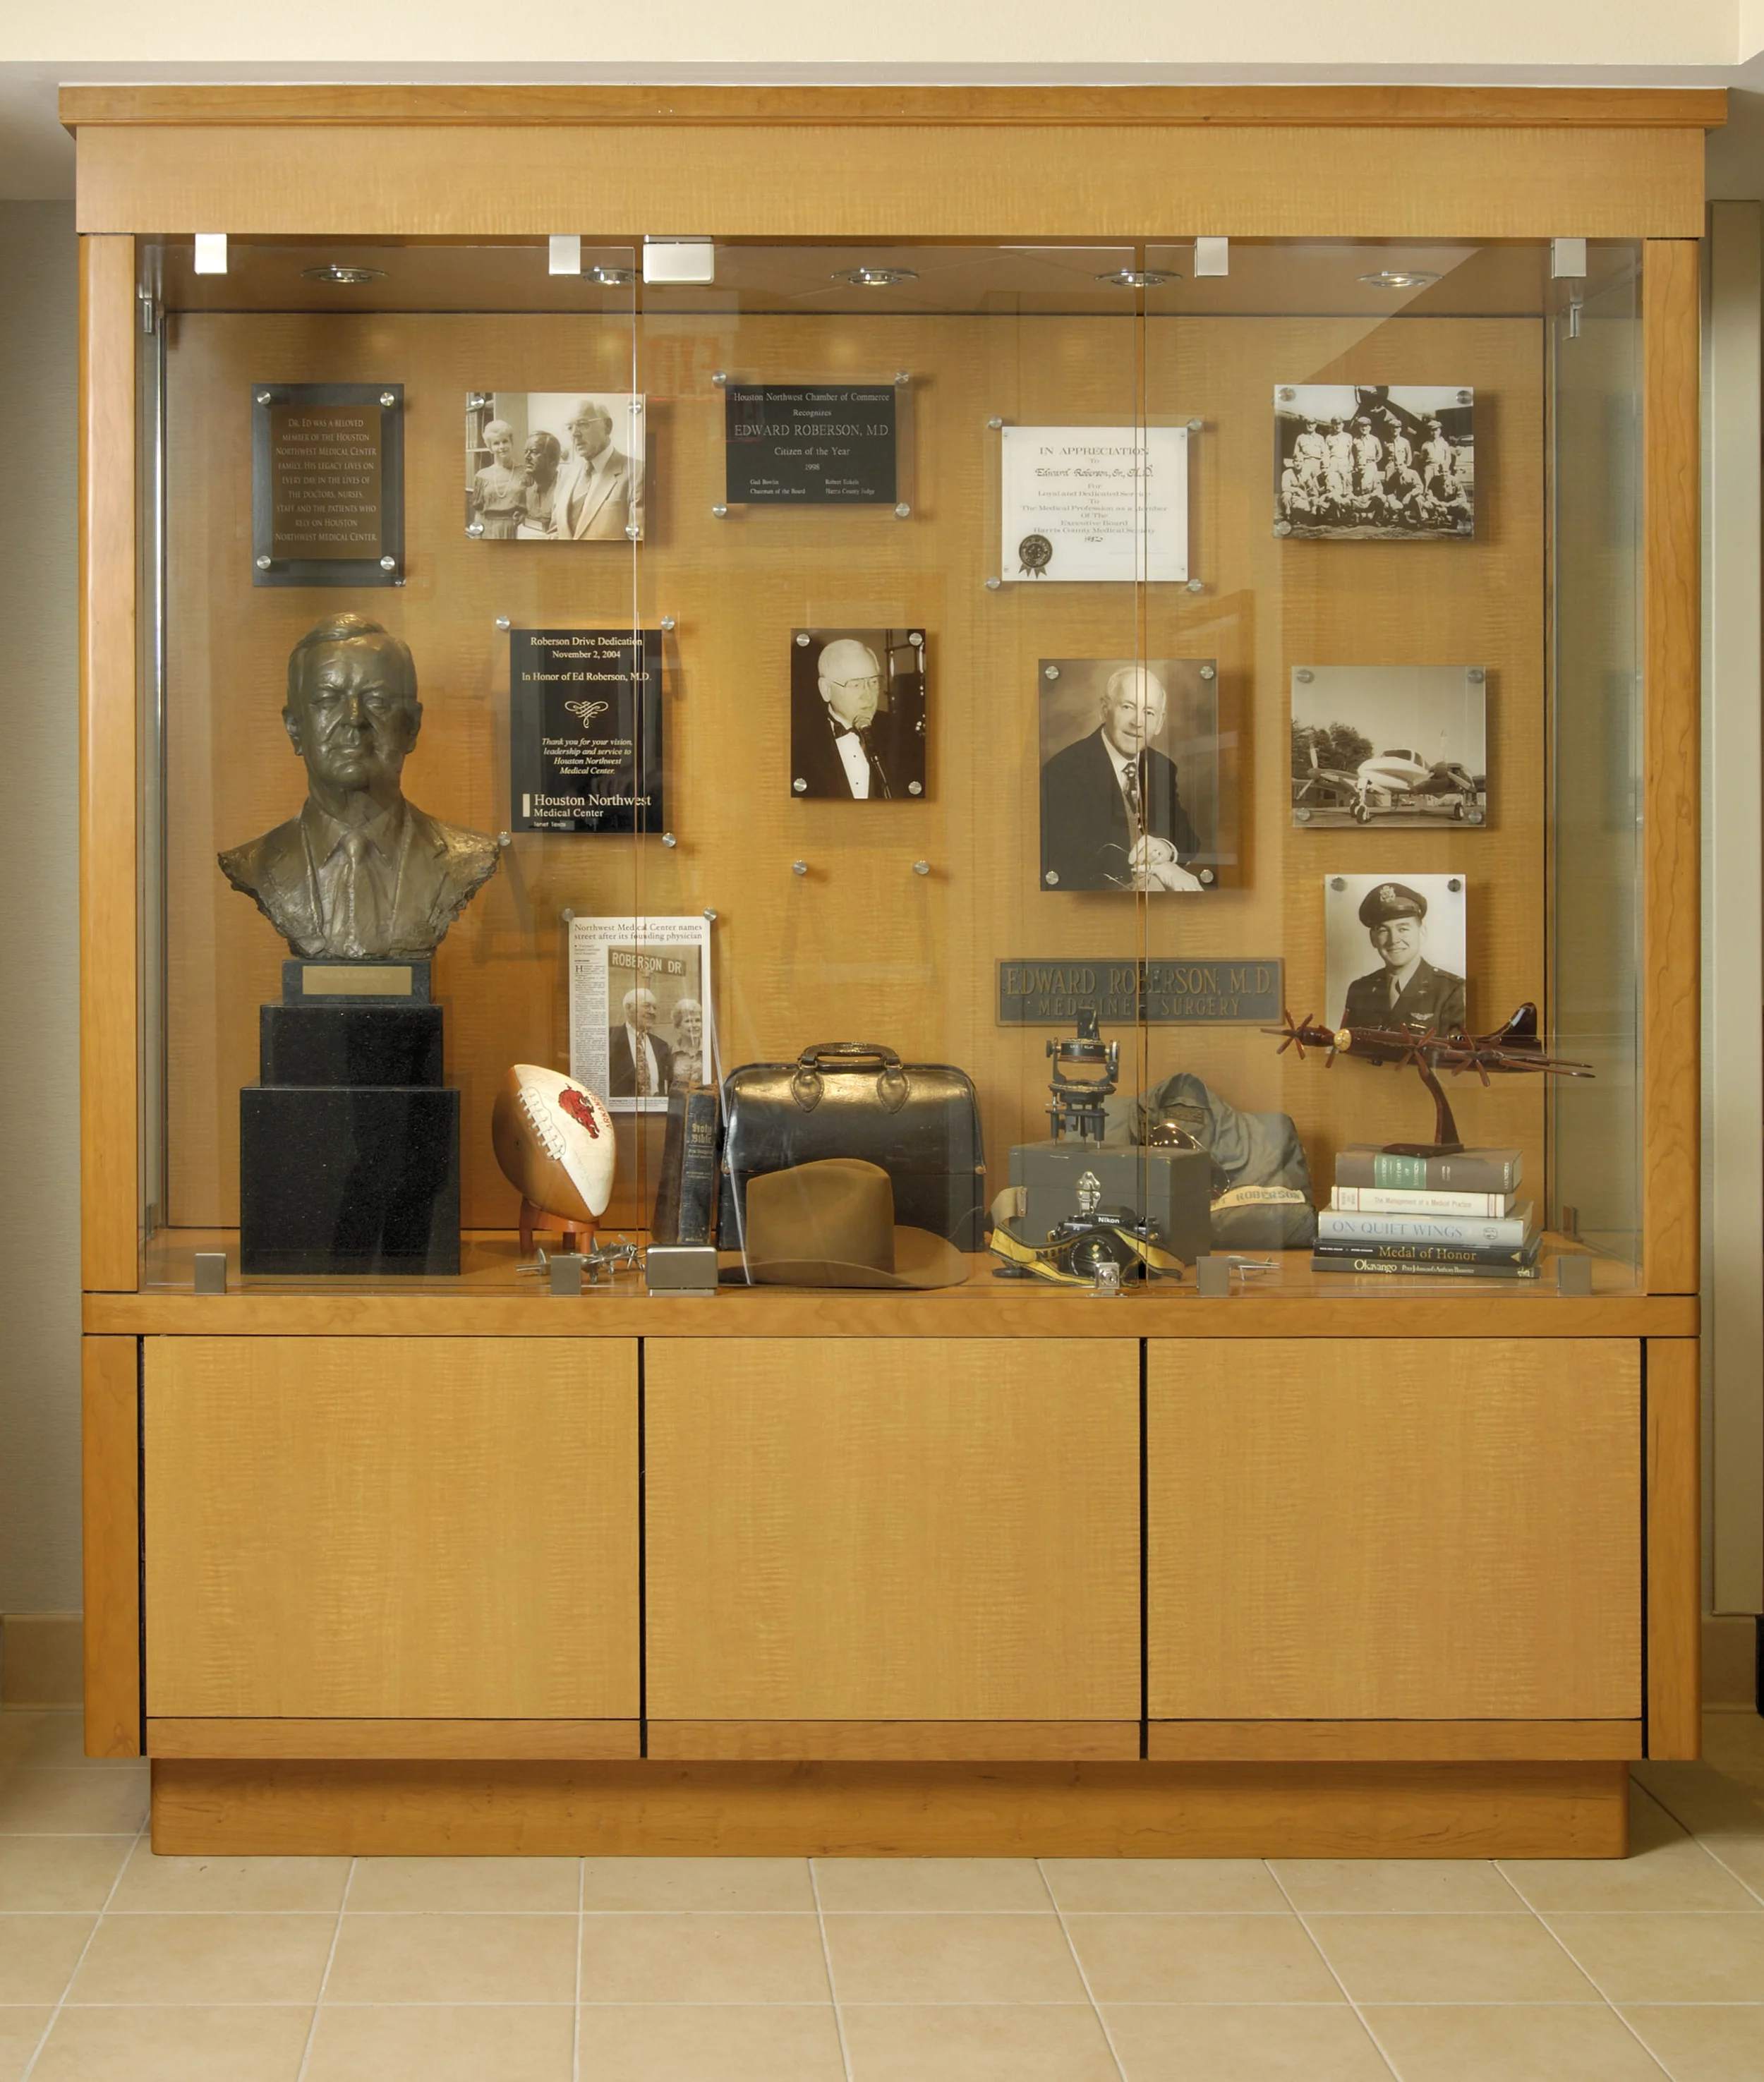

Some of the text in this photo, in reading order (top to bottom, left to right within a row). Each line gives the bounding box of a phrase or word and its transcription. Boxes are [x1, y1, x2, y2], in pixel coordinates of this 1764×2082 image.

[734, 392, 890, 401] Houston Northwest Chamber of Commerce
[792, 409, 832, 418] Recognizes
[735, 424, 790, 436] EDWARD
[795, 424, 862, 436] ROBERSON,
[310, 433, 319, 442] OF
[322, 433, 334, 442] THE
[336, 432, 370, 442] HOUSTON
[276, 447, 377, 456] NORTHWEST MEDICAL CENTER
[774, 447, 850, 456] Citizen of the Year
[1039, 447, 1149, 456] IN APPRECIATION
[275, 533, 316, 541] NORTHWEST
[318, 533, 348, 541] MEDICAL
[530, 636, 643, 646] Roberson Drive Dedication
[593, 650, 600, 660] 2,
[602, 650, 621, 658] 2004
[521, 672, 531, 681] In
[533, 672, 560, 681] Honor
[560, 672, 572, 681] of
[572, 672, 584, 681] Ed
[586, 672, 628, 682] Roberson,
[542, 737, 564, 746] Thank
[579, 737, 591, 747] for
[543, 747, 581, 756] leadership
[534, 794, 651, 806] Houston Northwest
[534, 809, 604, 817] Medical Center
[598, 931, 616, 940] after
[666, 932, 703, 941] physician
[612, 952, 683, 974] ROBERSON DR
[1005, 967, 1096, 995] EDWARD
[1109, 967, 1222, 997] ROBERSON,
[1161, 998, 1242, 1017] SURGERY
[691, 1122, 712, 1135] Holy
[691, 1133, 712, 1144] Bible
[1385, 1197, 1416, 1206] Management
[1431, 1199, 1451, 1207] Medical
[1332, 1221, 1463, 1237] ON QUIET WINGS
[1379, 1246, 1416, 1259] Medal
[1420, 1246, 1433, 1259] of
[1436, 1248, 1477, 1261] Honor
[1354, 1259, 1398, 1274] Okavango
